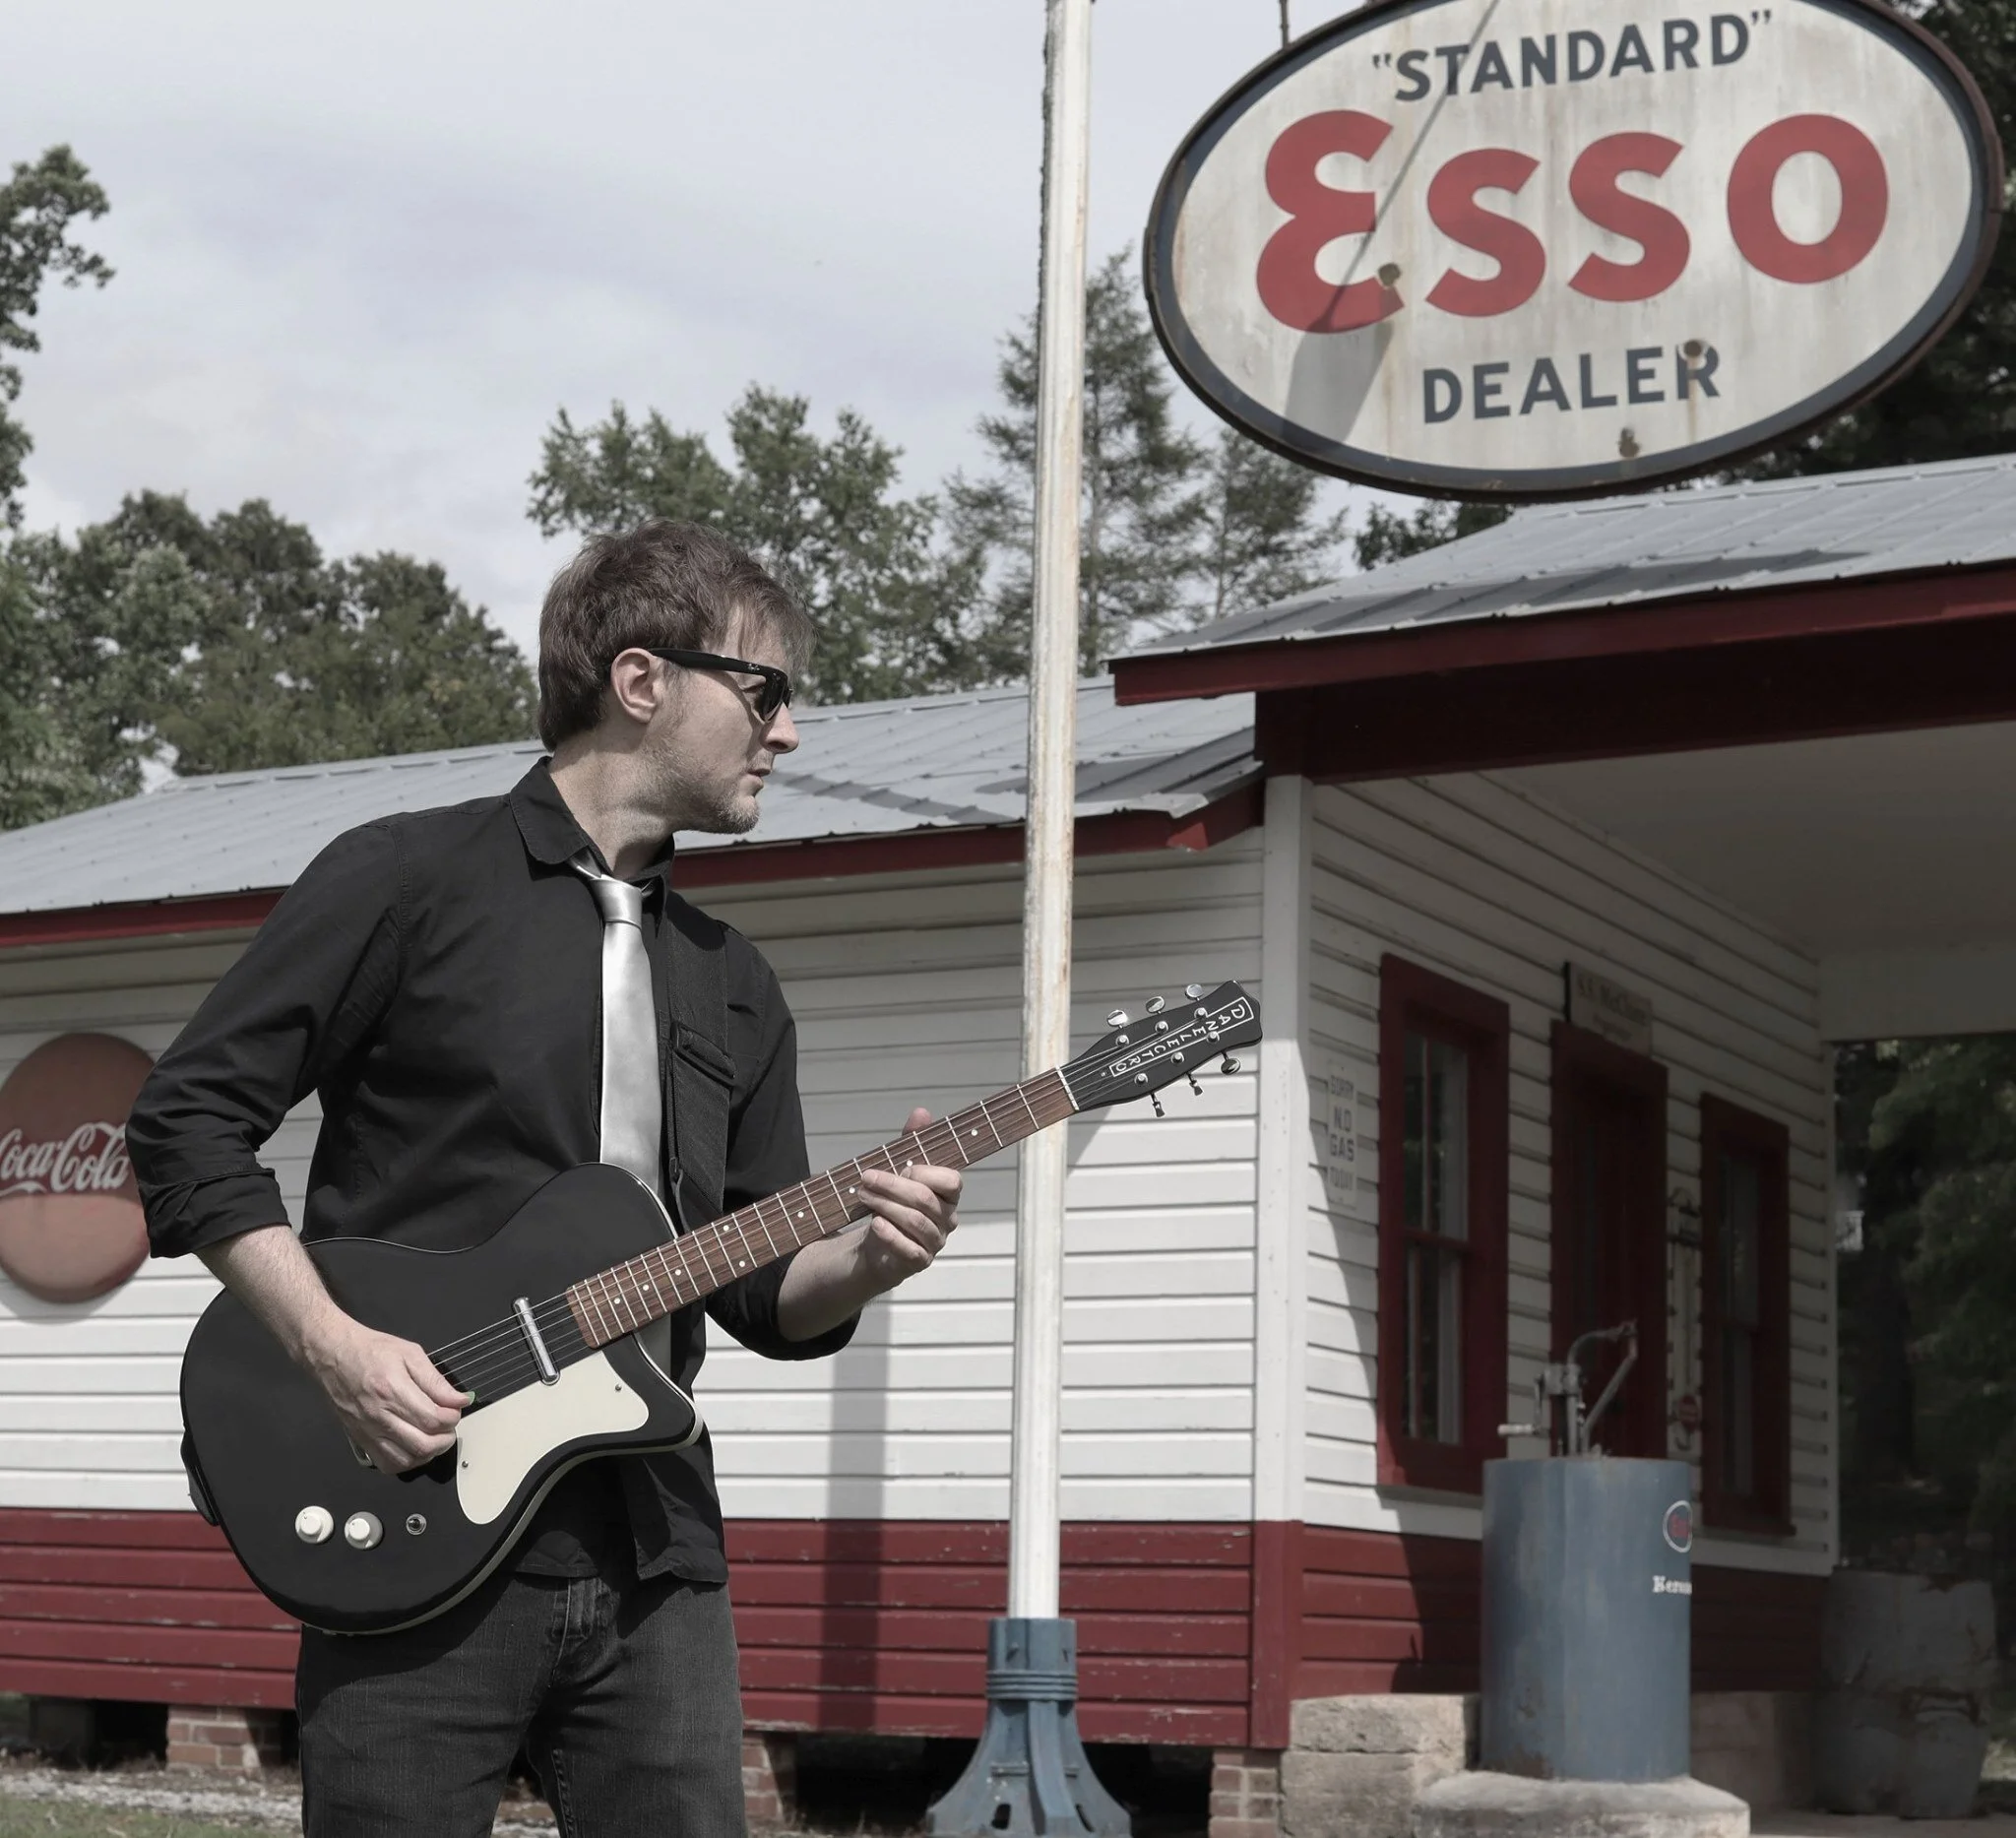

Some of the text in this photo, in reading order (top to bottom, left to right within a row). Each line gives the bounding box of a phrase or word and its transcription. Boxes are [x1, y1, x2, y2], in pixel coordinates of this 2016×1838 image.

[1423, 342, 1721, 424] DEALER
[1115, 1003, 1246, 1072] DANELECTRO
[1334, 1106, 1353, 1133] NO
[1330, 1133, 1354, 1162] GAS
